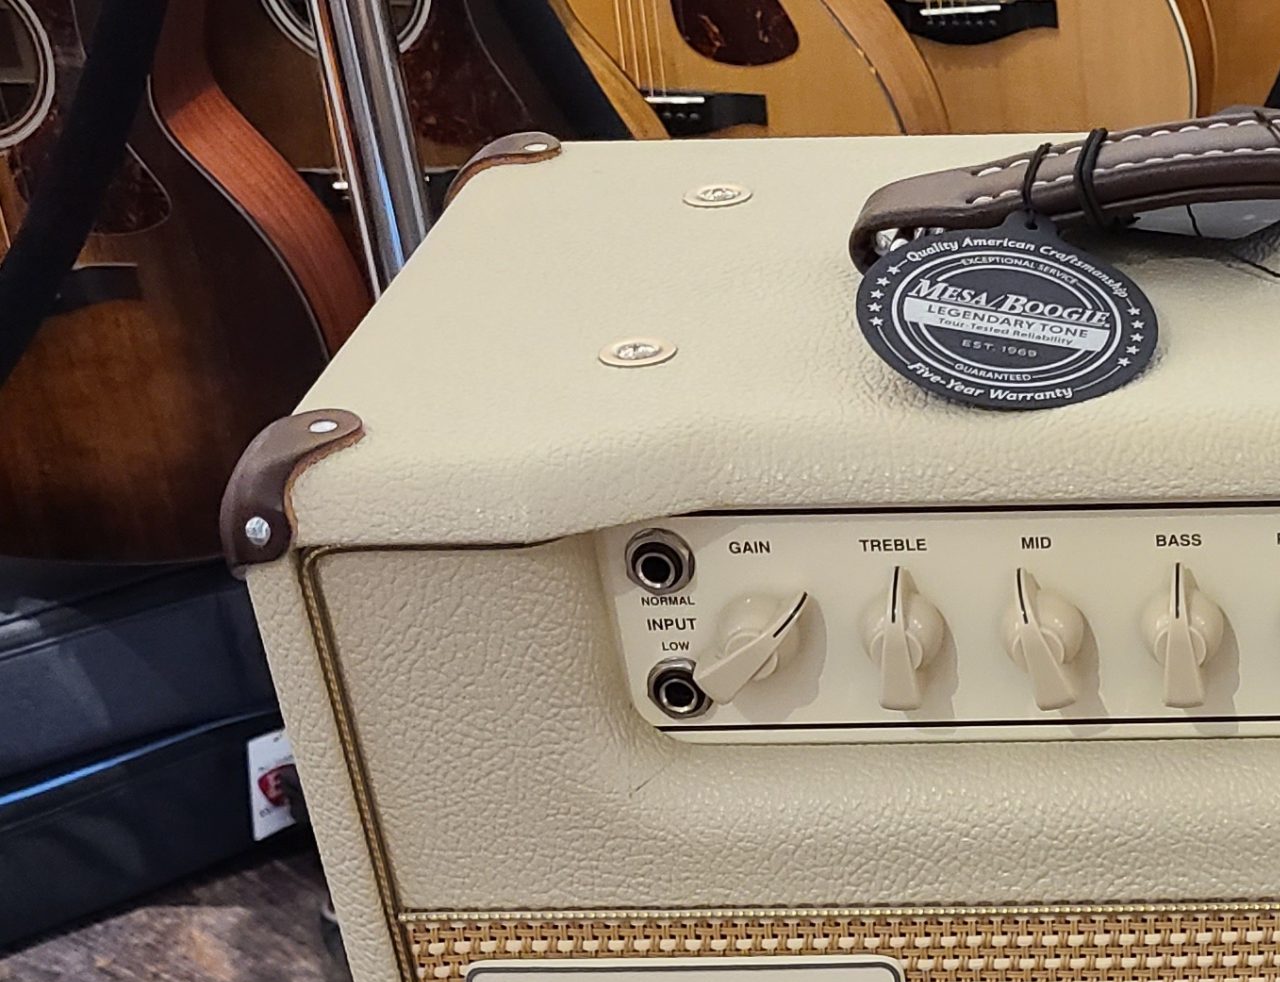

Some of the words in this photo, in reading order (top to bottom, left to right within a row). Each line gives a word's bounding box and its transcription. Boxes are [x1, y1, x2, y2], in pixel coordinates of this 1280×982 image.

[906, 240, 959, 262] Quality
[962, 236, 1036, 252] American
[1039, 245, 1129, 298] Craftsmanship
[960, 255, 1037, 269] EXCEPTIONAL
[1037, 262, 1079, 286] SERVICE
[927, 304, 1035, 331] LEGENDARY
[1040, 322, 1089, 339] TONE
[961, 339, 996, 351] EST.
[1012, 330, 1074, 346] Reliability
[954, 363, 1032, 382] GUARANTEED
[908, 361, 985, 397] Five-Year
[989, 387, 1073, 402] Warranty
[728, 540, 771, 555] GAIN
[858, 538, 927, 552] TREBLE
[1021, 536, 1052, 550] MID
[1155, 534, 1202, 547] BASS
[641, 596, 695, 606] NORMAL
[647, 618, 696, 631] INPUT
[661, 641, 690, 651] LOW
